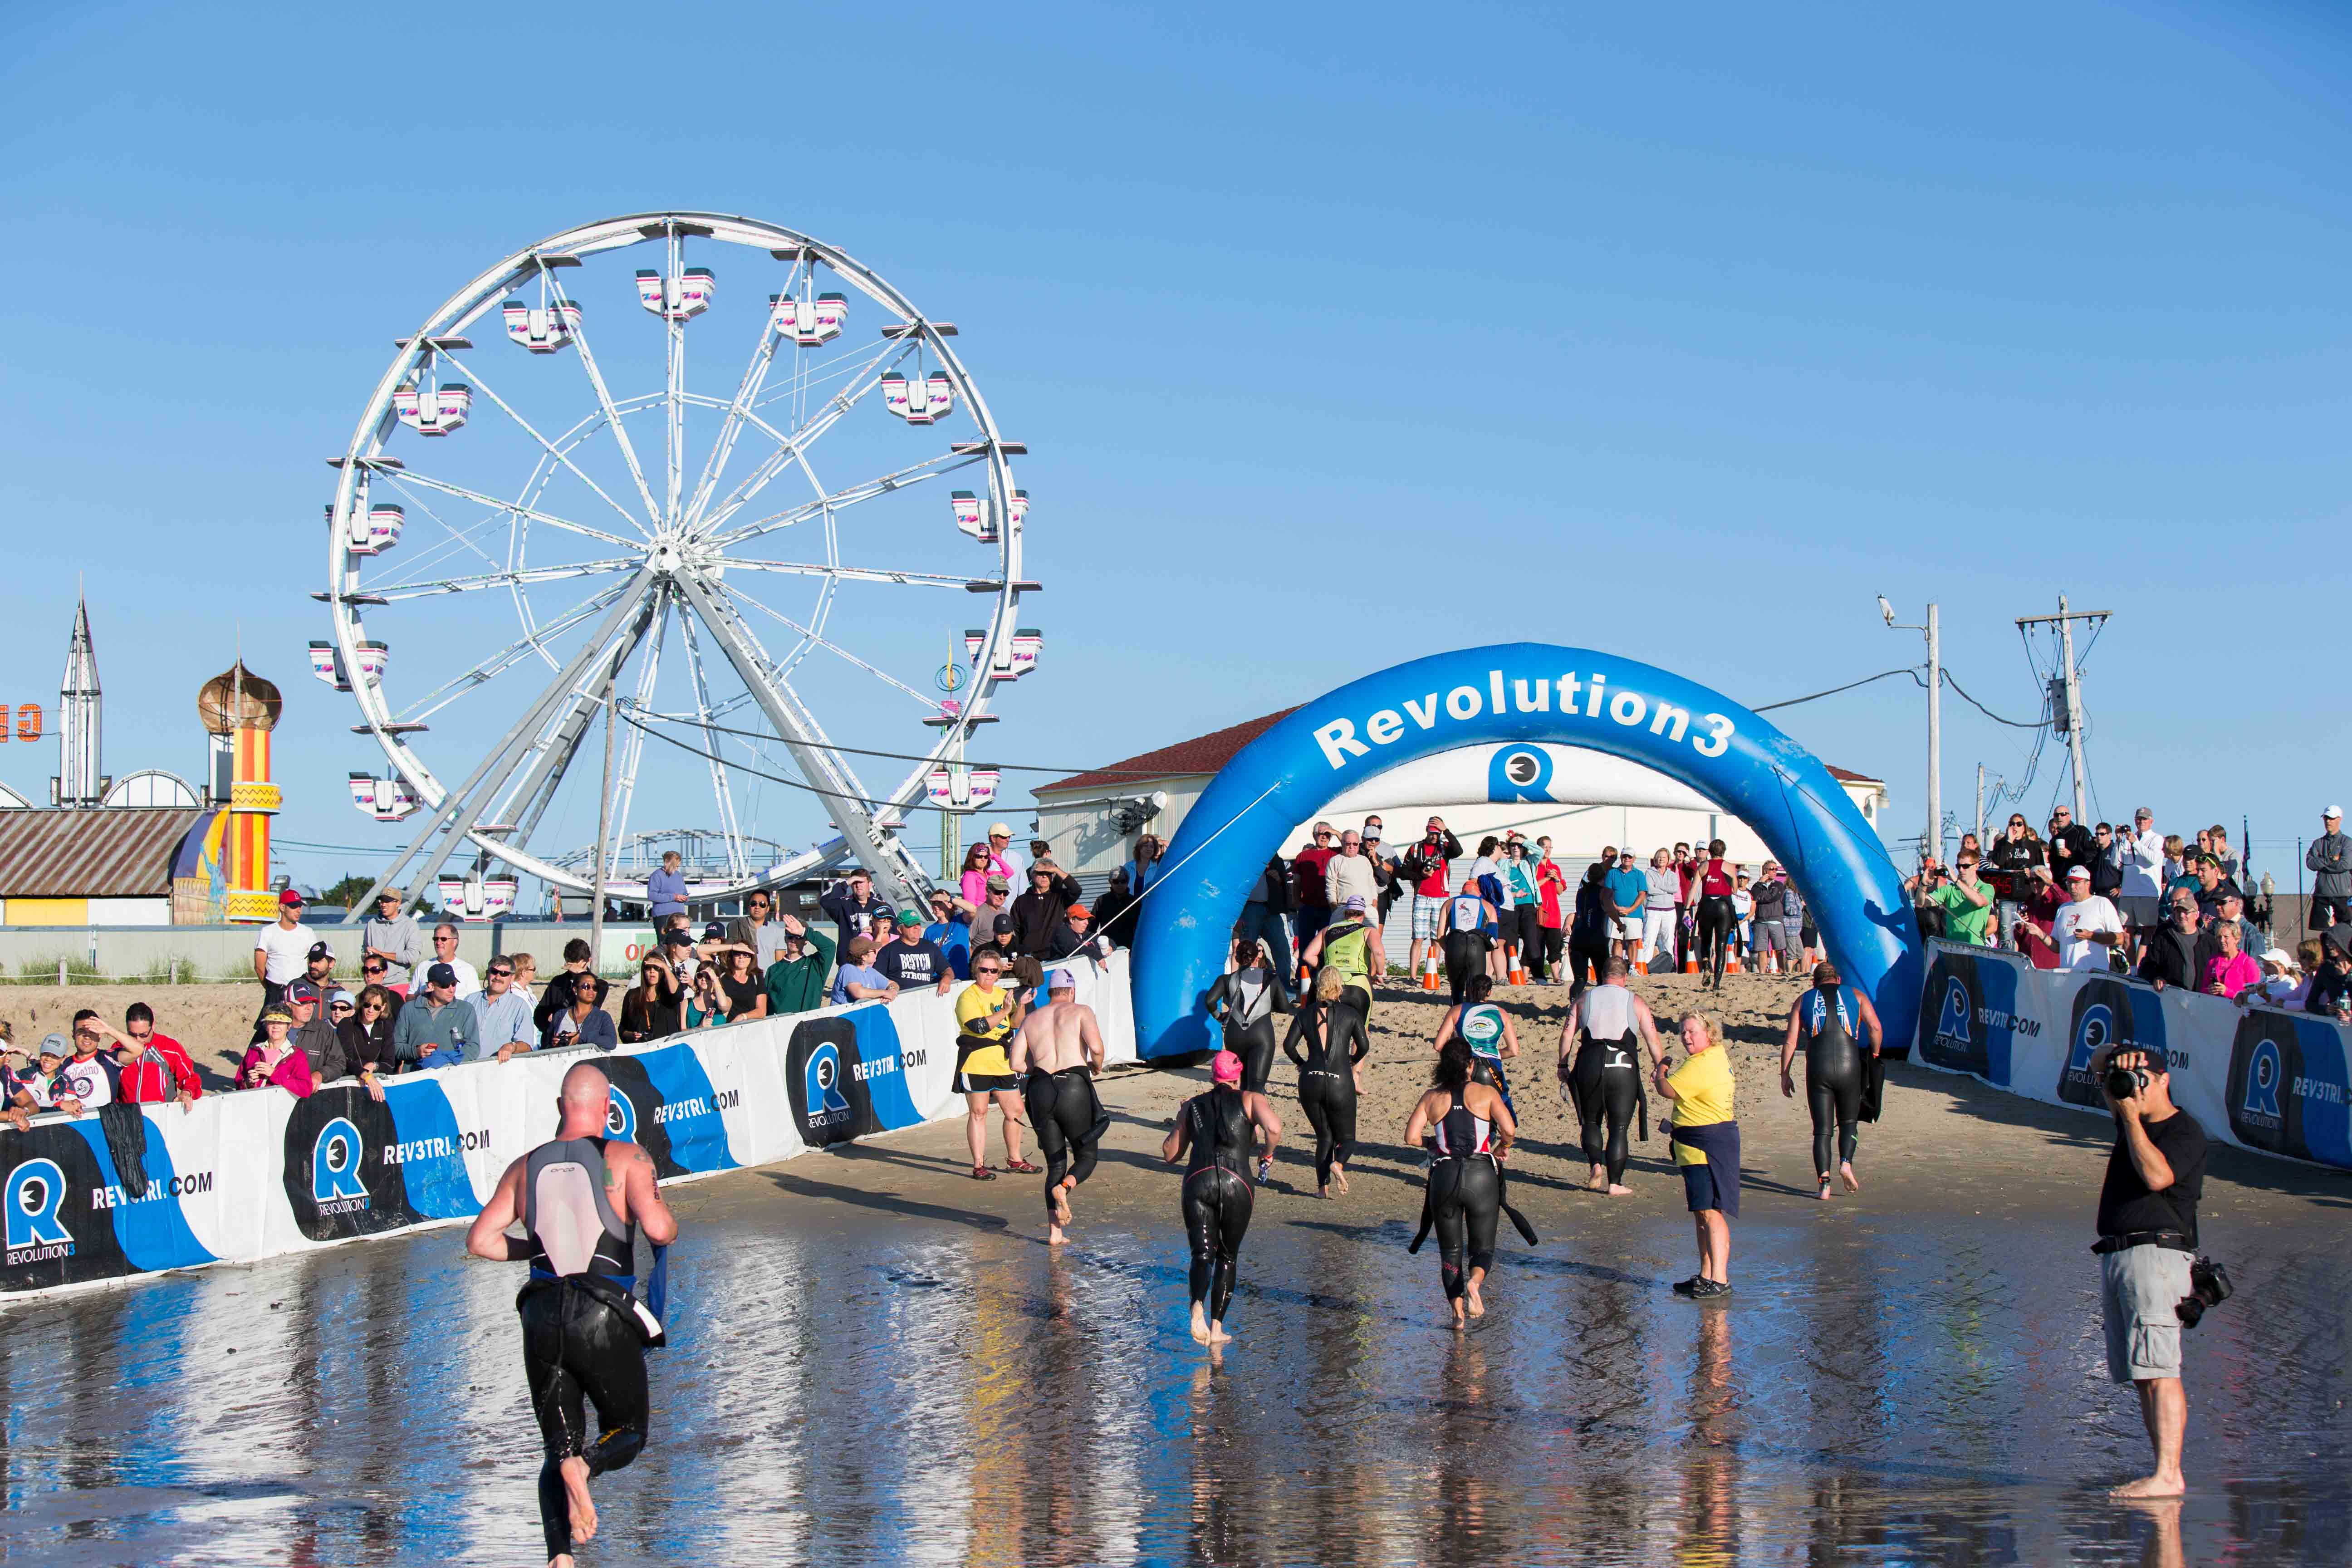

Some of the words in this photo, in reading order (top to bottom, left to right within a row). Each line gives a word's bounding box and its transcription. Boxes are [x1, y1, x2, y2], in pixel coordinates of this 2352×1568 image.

[1313, 670, 1735, 770] Revolution3
[899, 953, 931, 971] BOSTON
[901, 971, 930, 981] STRONG
[653, 1089, 740, 1125] REV3TRI.COM
[383, 1129, 490, 1166] REV3TRI.COM
[92, 1171, 212, 1210] REVRI.COM
[7, 1244, 75, 1266] REVOLUTION3
